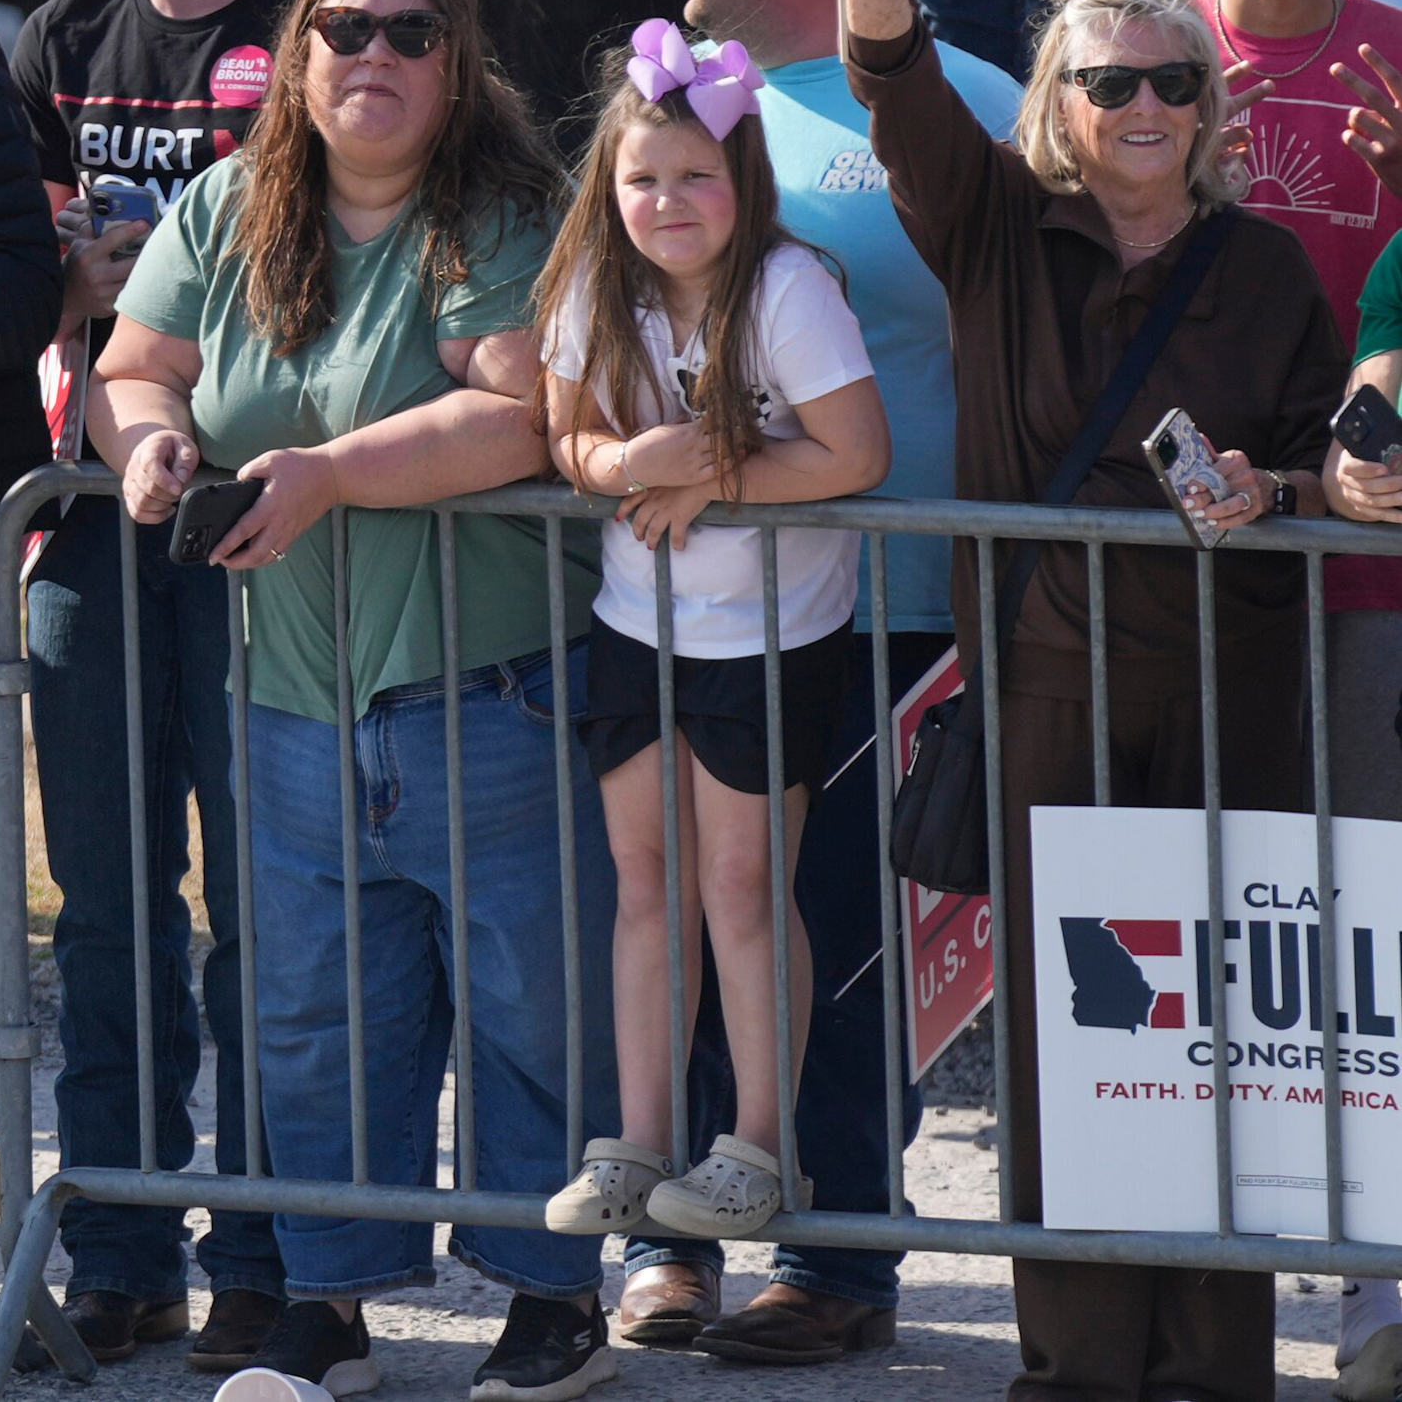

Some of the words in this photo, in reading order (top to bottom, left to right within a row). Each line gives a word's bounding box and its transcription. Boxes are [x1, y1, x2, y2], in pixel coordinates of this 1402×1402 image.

[216, 69, 268, 81] BROWN
[220, 58, 255, 70] BEAU
[80, 123, 204, 170] BURT
[1244, 883, 1342, 911] CLA
[920, 939, 966, 1009] U.S.
[1195, 920, 1402, 1038] FULL
[1187, 1041, 1401, 1077] CONGRESS
[1096, 1082, 1185, 1100] FAITH.
[1285, 1086, 1399, 1111] AMRICA
